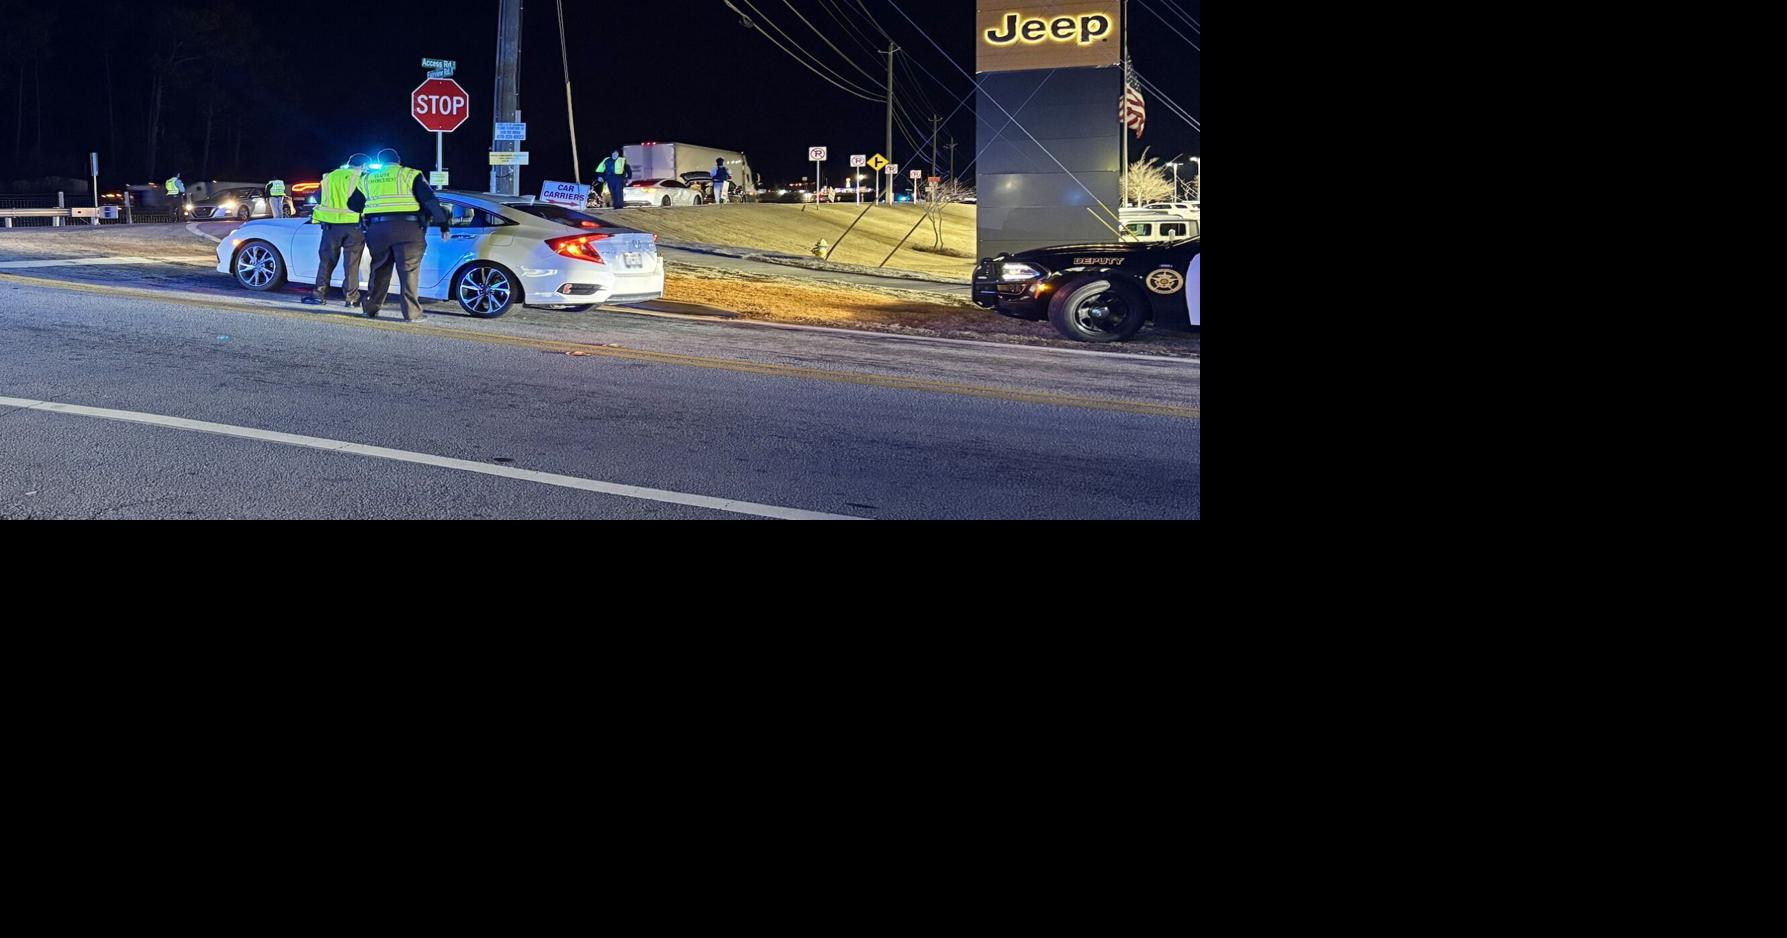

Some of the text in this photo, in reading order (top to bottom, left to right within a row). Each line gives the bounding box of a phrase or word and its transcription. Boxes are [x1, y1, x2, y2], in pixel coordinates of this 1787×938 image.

[987, 14, 1109, 43] Jeep
[422, 57, 442, 68] Access
[416, 94, 465, 115] STOP
[557, 184, 575, 192] CAR
[543, 190, 585, 201] CARRIERS
[1073, 257, 1125, 265] DEPUTY
